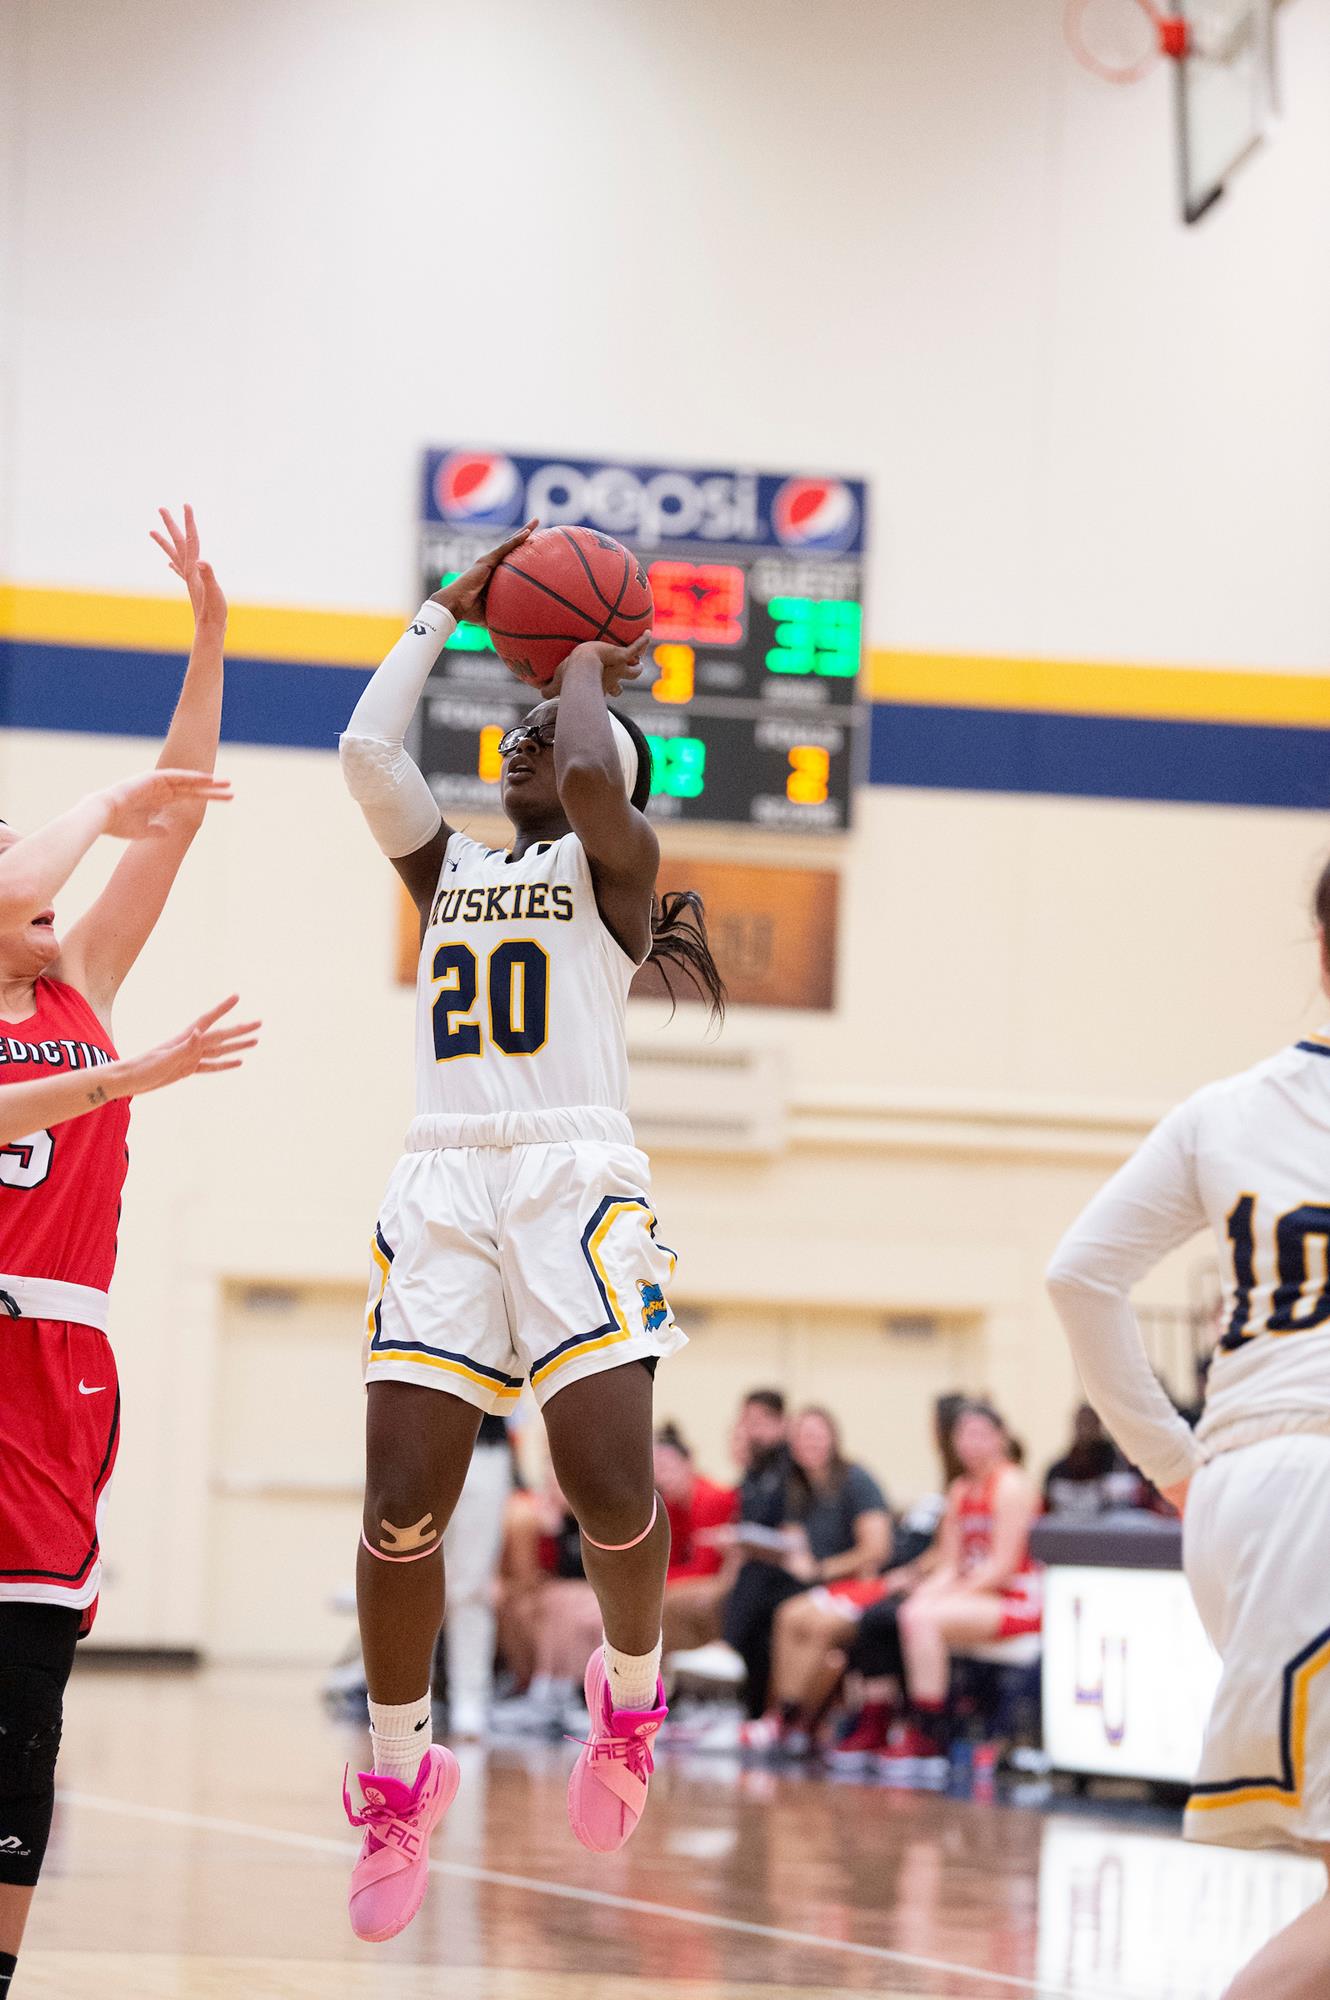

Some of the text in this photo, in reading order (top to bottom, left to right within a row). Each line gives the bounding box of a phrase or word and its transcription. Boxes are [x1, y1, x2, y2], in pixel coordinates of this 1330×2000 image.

[525, 464, 760, 549] pepsi
[0, 1036, 116, 1069] DICTIN
[431, 937, 550, 1063] 20
[1219, 1192, 1330, 1356] 10
